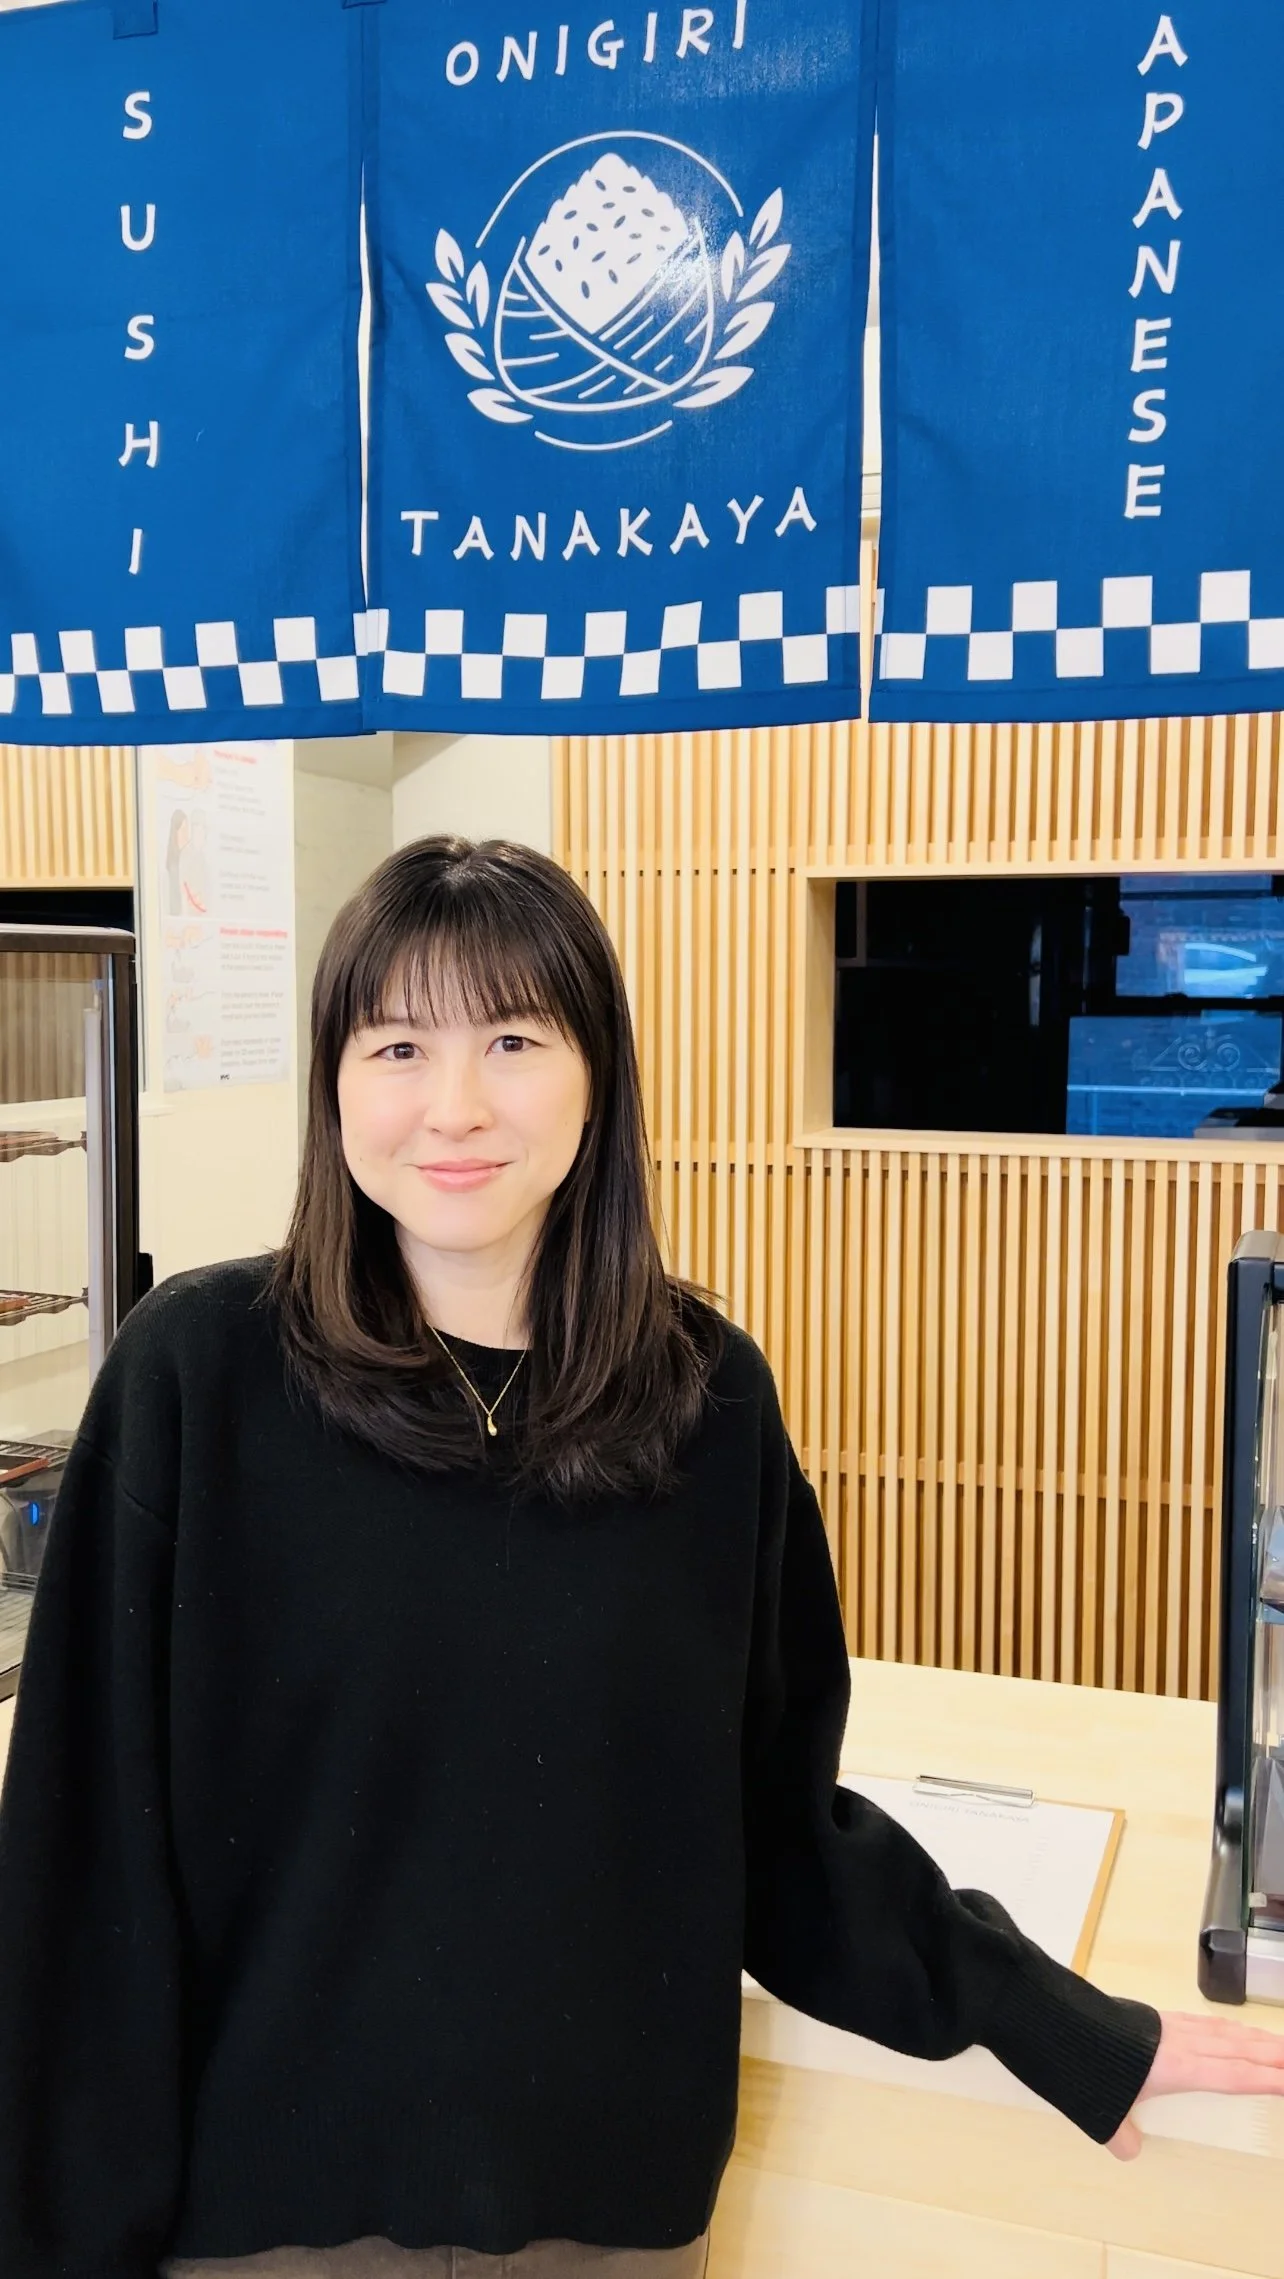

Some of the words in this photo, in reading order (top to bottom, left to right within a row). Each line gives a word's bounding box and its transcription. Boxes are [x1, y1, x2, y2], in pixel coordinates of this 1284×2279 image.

[445, 0, 747, 86] ONIGIRI
[118, 91, 159, 575] SUSHI
[400, 486, 817, 561] TANAKAYA
